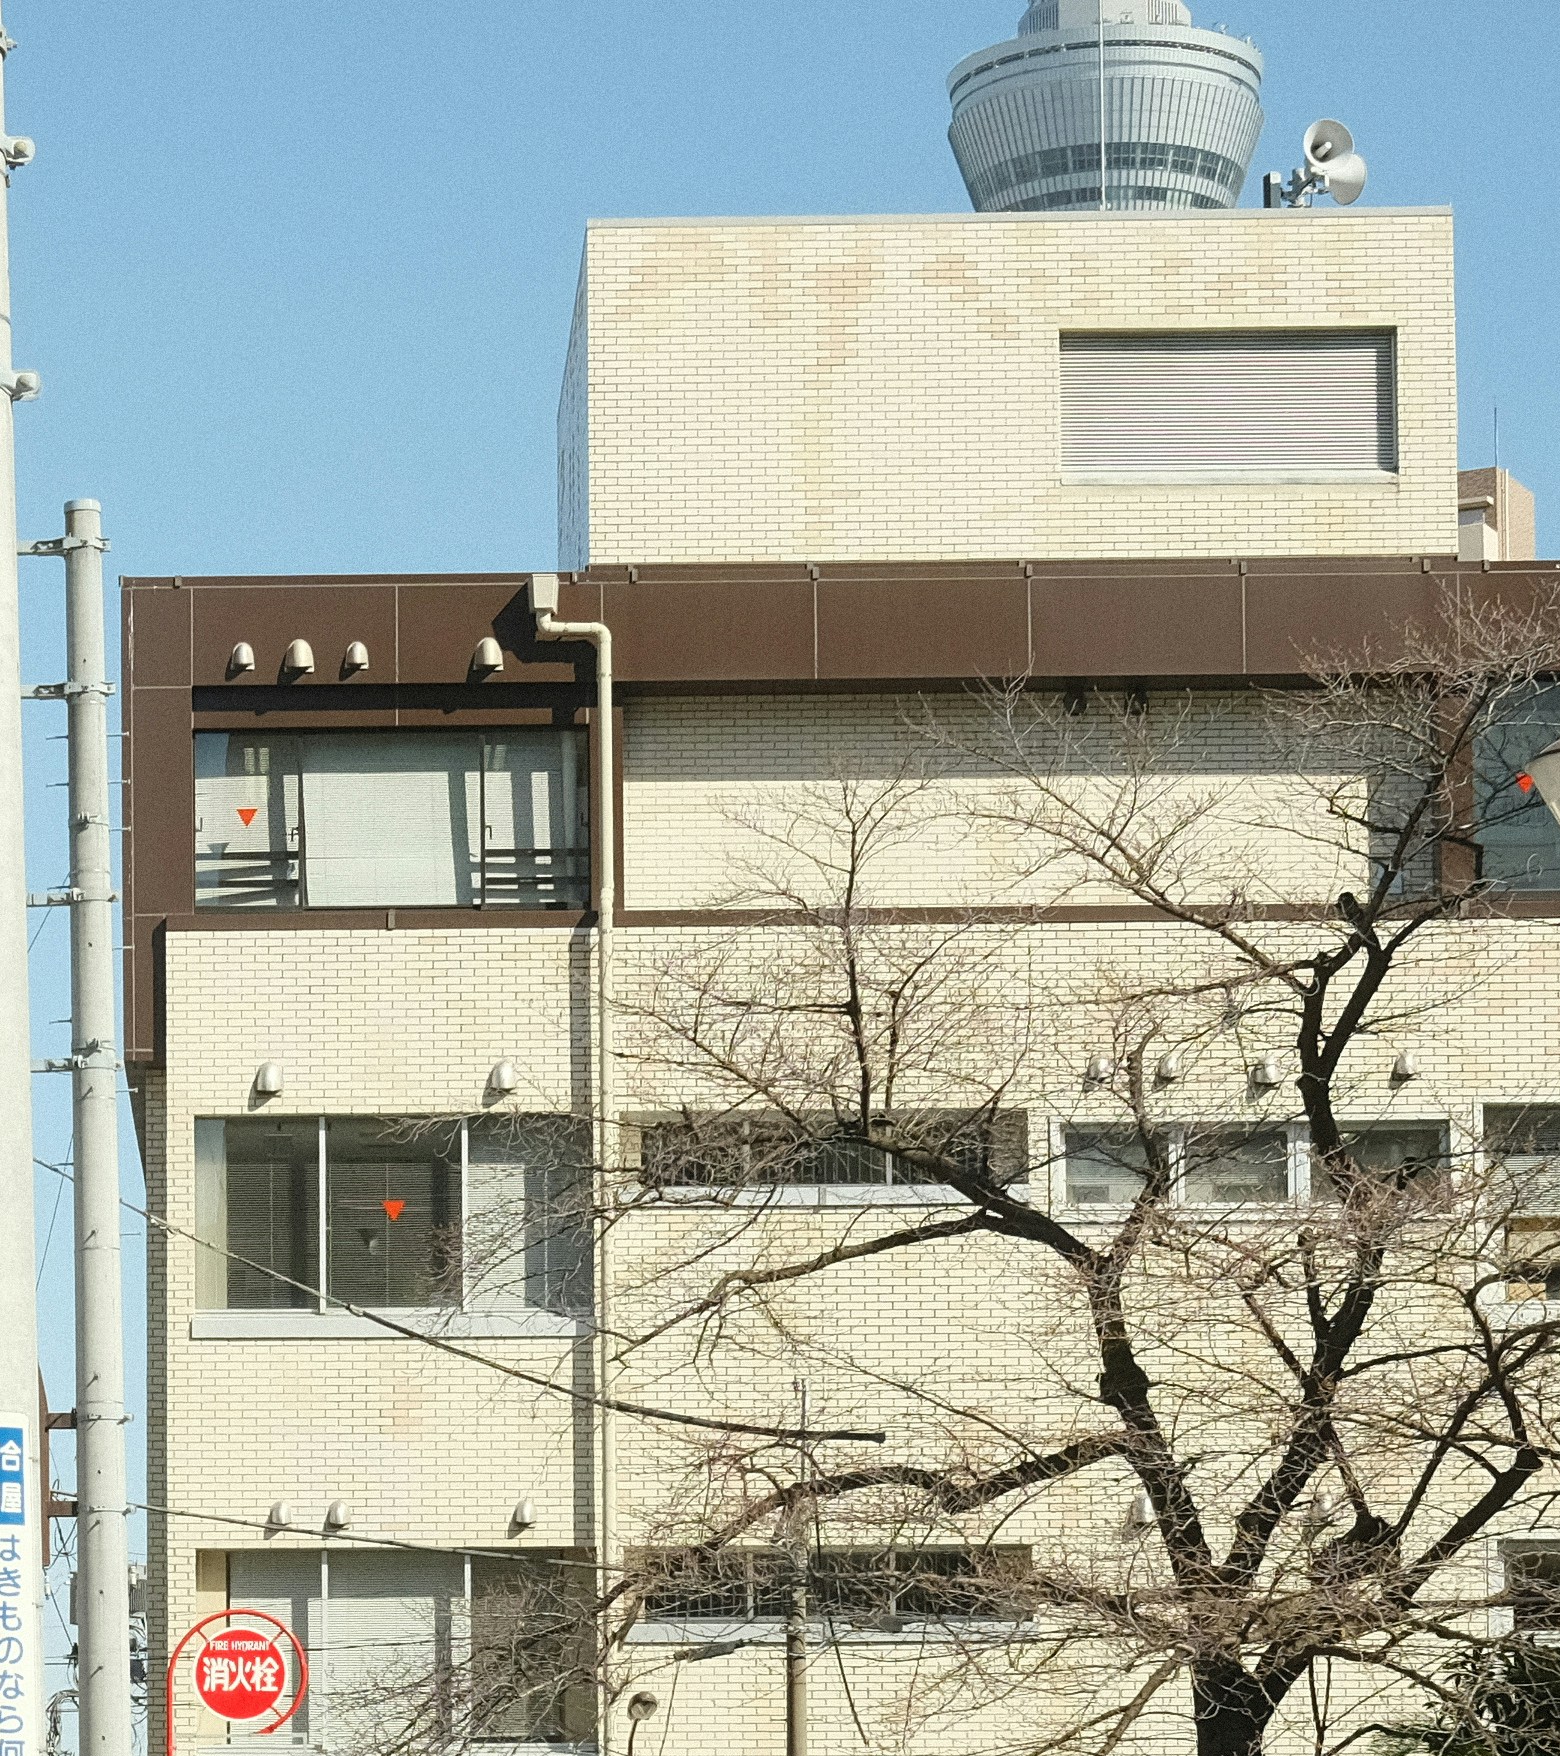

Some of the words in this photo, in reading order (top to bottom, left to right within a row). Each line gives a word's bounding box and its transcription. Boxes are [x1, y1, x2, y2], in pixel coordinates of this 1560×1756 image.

[210, 1641, 229, 1651] FIRE
[231, 1641, 270, 1652] HYDRANT
[203, 1657, 280, 1692] 消火栓
